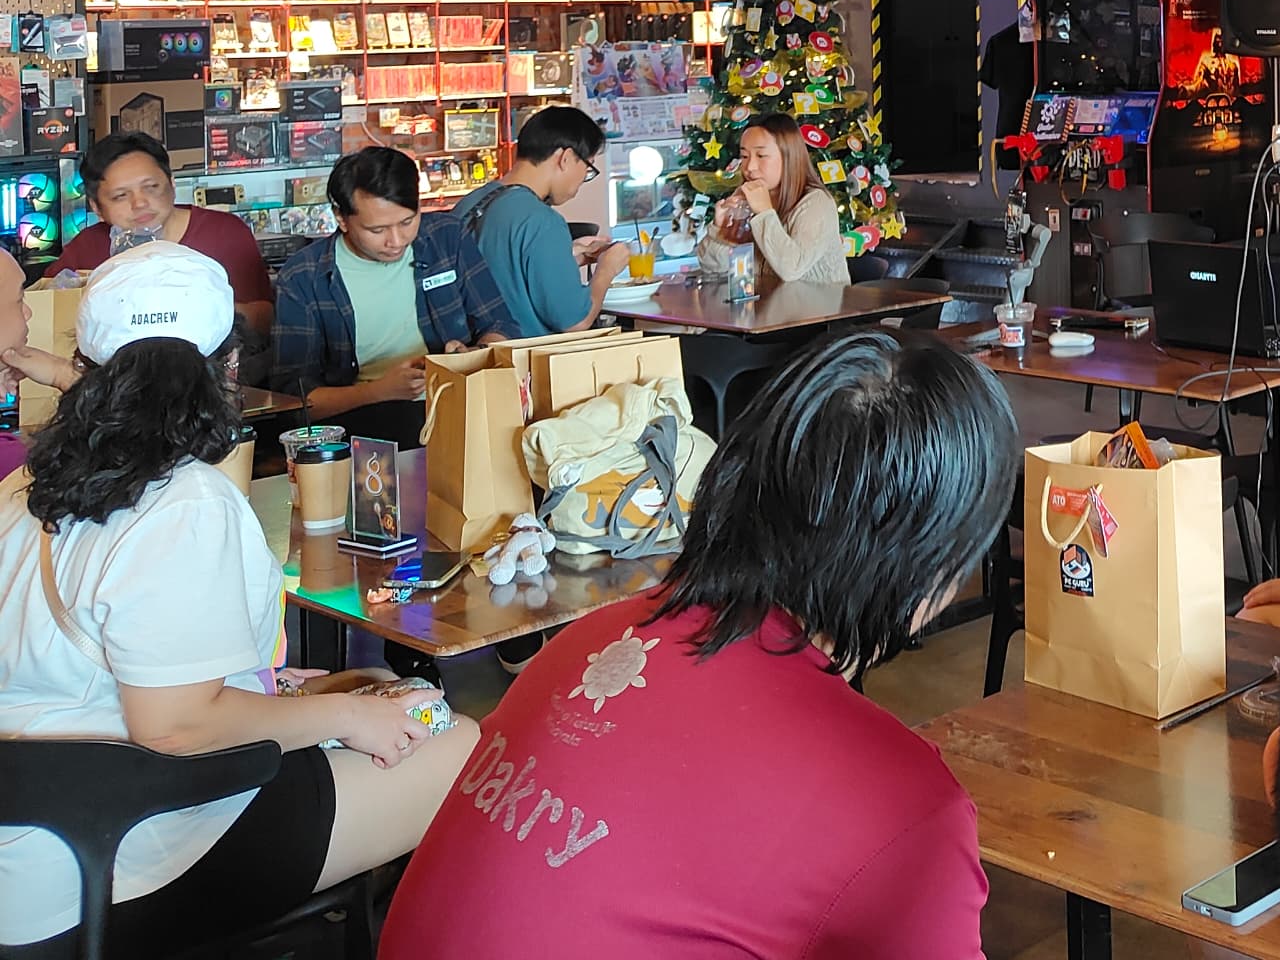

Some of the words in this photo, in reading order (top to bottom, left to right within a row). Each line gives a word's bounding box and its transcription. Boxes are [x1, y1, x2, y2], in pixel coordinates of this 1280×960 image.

[37, 125, 69, 135] RYZEN
[365, 451, 383, 496] 8
[1052, 495, 1066, 506] ATO
